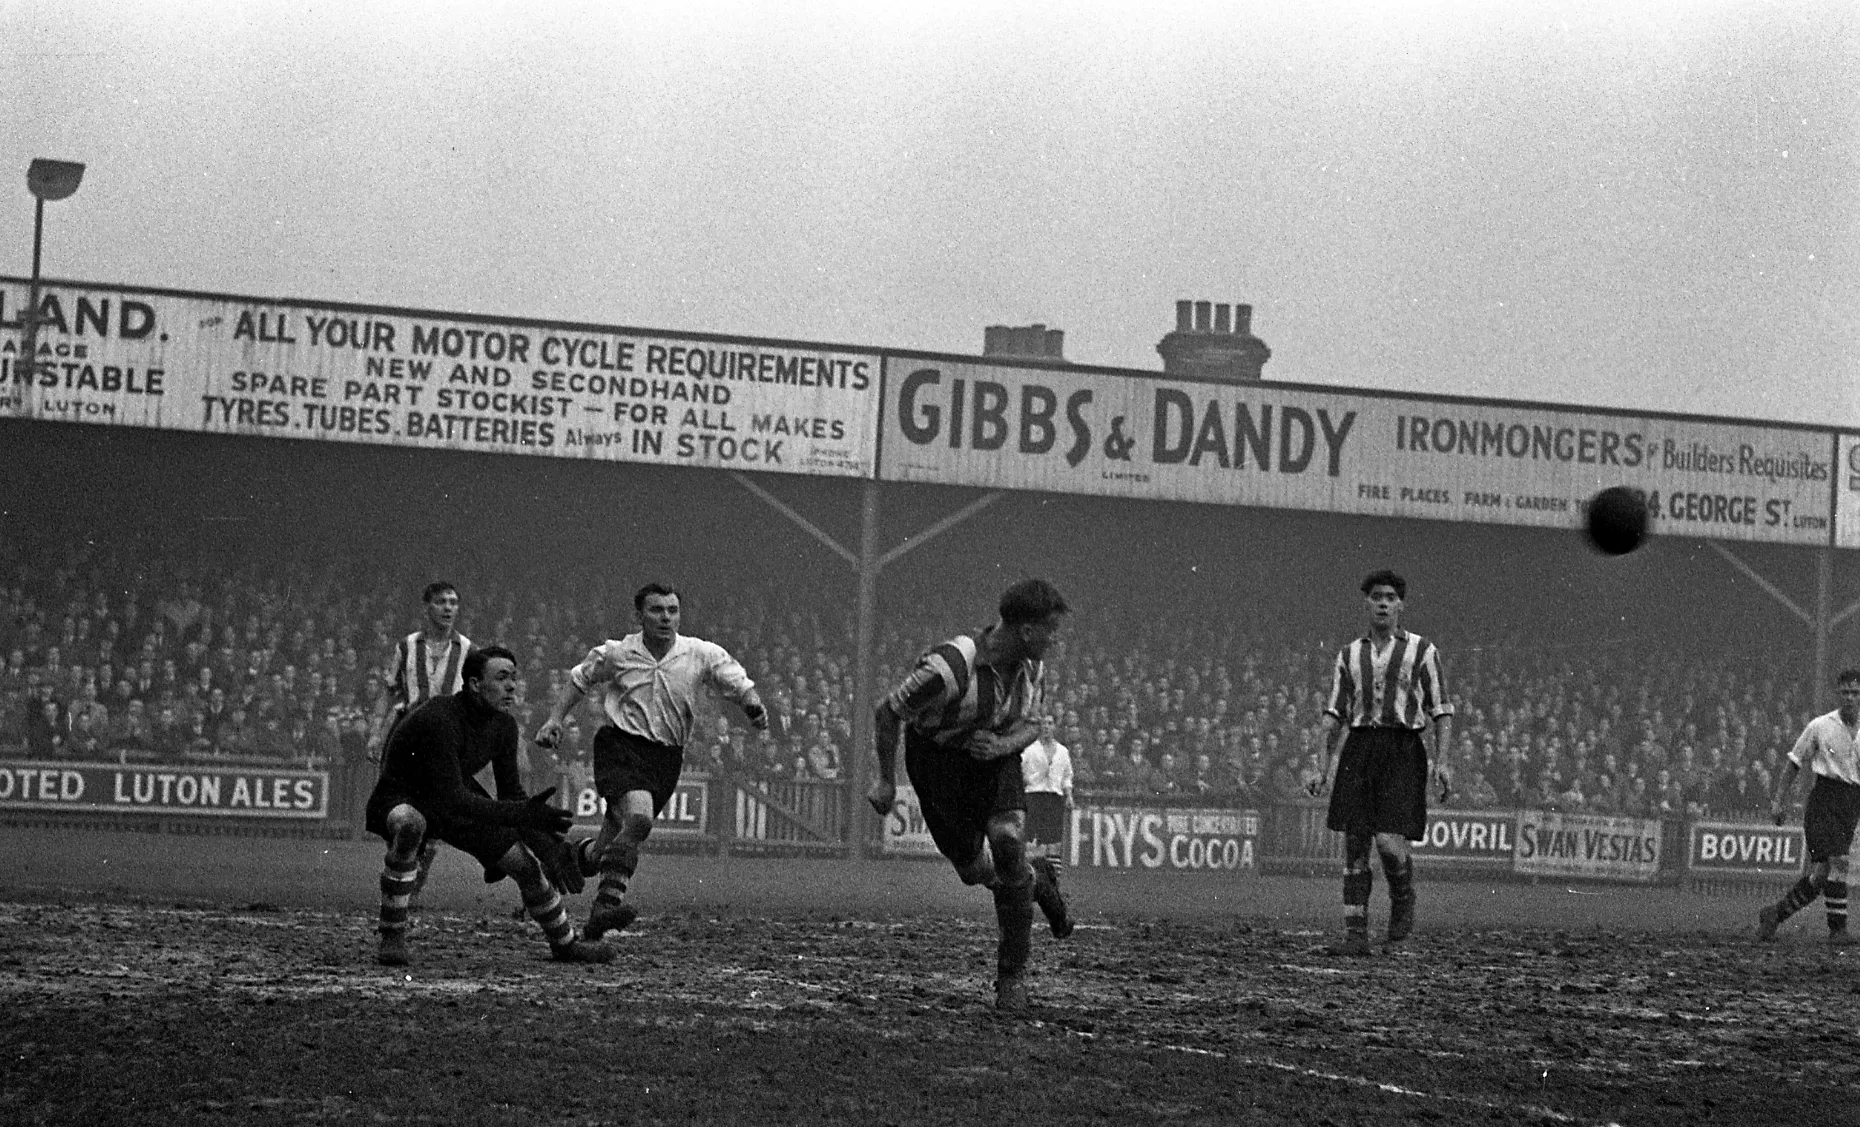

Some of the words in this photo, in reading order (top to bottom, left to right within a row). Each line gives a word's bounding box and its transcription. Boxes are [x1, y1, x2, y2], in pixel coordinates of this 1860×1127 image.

[234, 310, 296, 345] ALL
[305, 315, 396, 352] YOUR
[412, 324, 530, 363] MOTOR
[541, 336, 635, 371] CYCLE
[646, 344, 870, 391] REQUIREMENTS
[366, 356, 433, 380] NEW
[449, 363, 512, 387] AND
[531, 370, 731, 406] SECONDHAND
[44, 400, 116, 415] LUTON
[231, 371, 327, 399] SPARE
[344, 380, 423, 406] PART
[437, 388, 574, 418] STOCKIST
[613, 402, 668, 426] FOR
[681, 408, 736, 432] ALL
[751, 413, 845, 440] MAKES
[899, 368, 1094, 469] GIBBS
[1103, 415, 1136, 462] &
[1152, 387, 1358, 478] DANDY
[407, 410, 555, 447] BATTERIES
[565, 428, 622, 447] Always
[631, 429, 663, 456] IN
[676, 434, 785, 465] STOCK
[1396, 415, 1644, 468] IRONMONGERS
[1663, 438, 1735, 474] Builders
[1739, 443, 1828, 485] Requisites
[1357, 483, 1391, 501] FIRE
[1401, 487, 1450, 504] PLACES
[1464, 491, 1502, 508] FARM
[1515, 495, 1568, 512] GARDEN
[1669, 491, 1757, 526] GEORGE
[113, 772, 222, 807] LUTON
[230, 776, 315, 810] ALES
[1069, 808, 1165, 869] FRYS
[1170, 834, 1255, 870] COCOA
[1520, 824, 1578, 859] SWAN
[1584, 829, 1657, 864] VESTAS
[1700, 833, 1797, 864] BOVRIL
